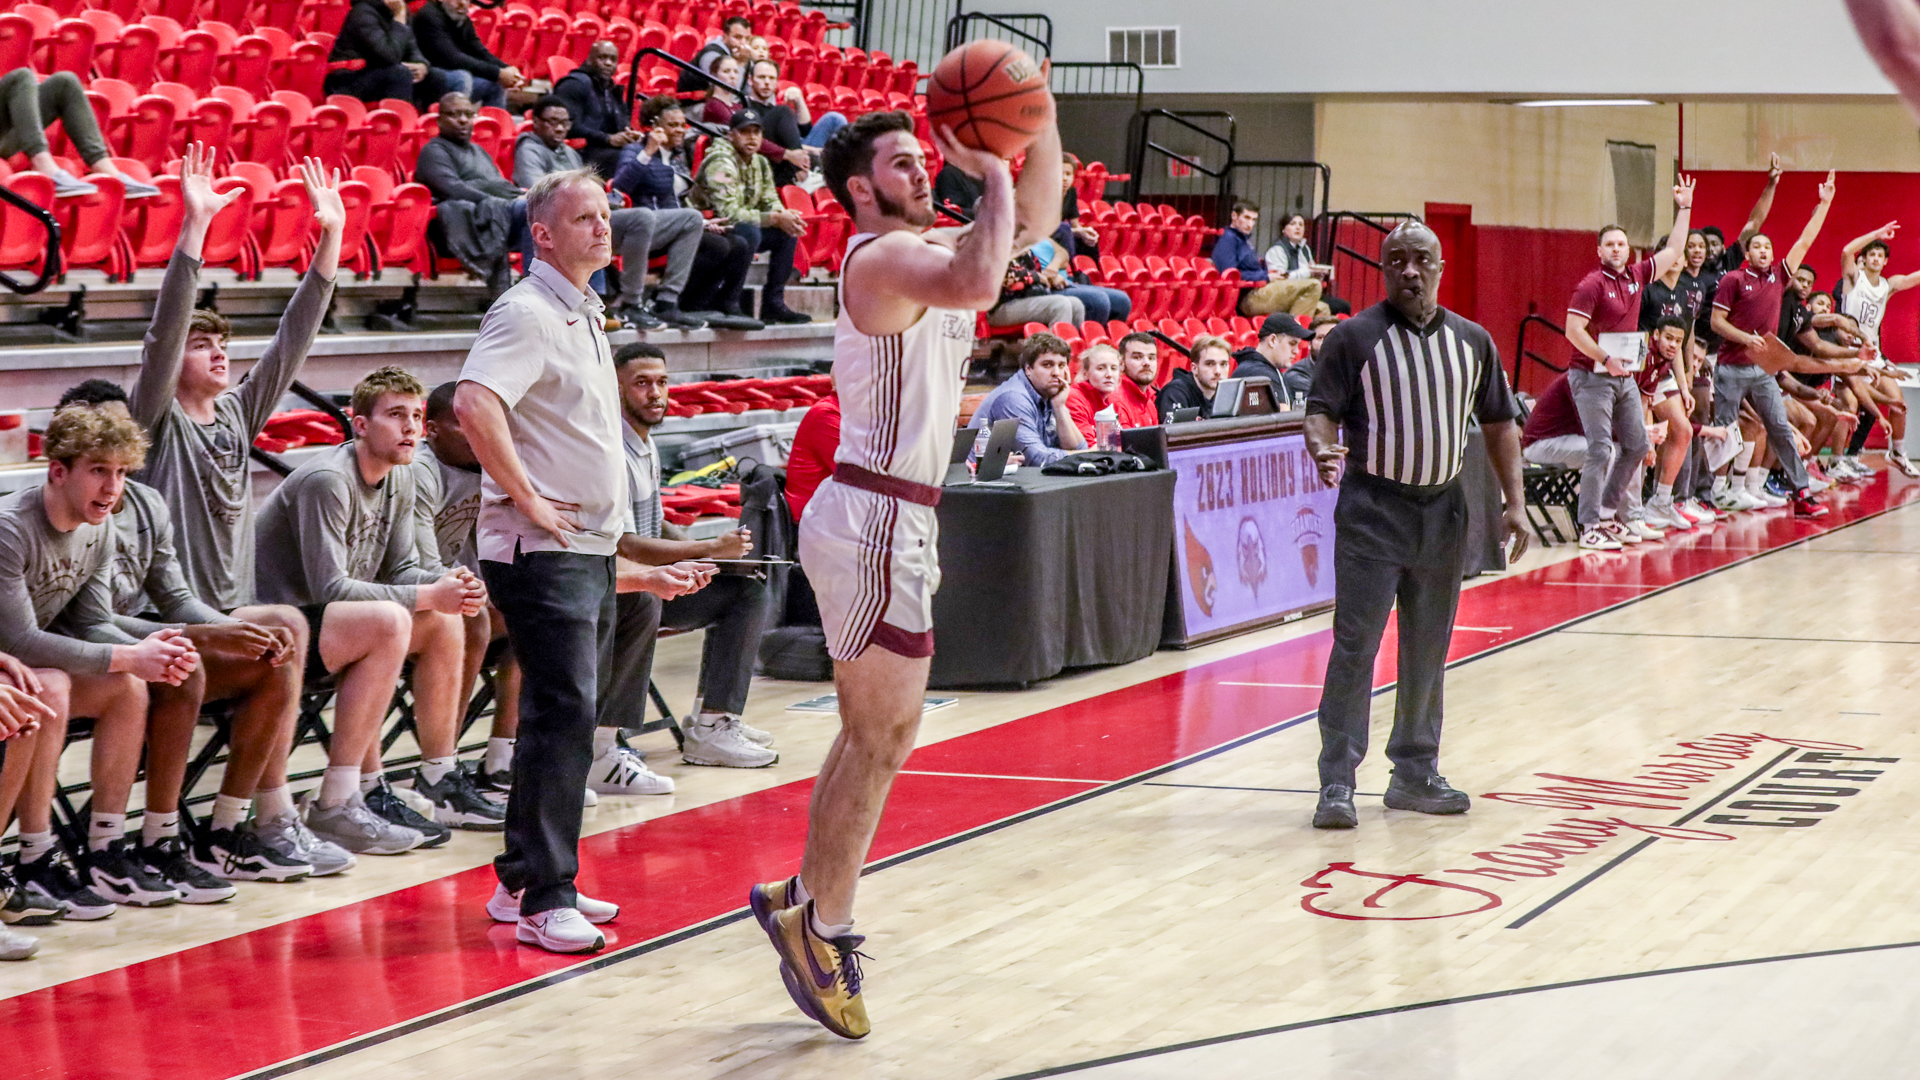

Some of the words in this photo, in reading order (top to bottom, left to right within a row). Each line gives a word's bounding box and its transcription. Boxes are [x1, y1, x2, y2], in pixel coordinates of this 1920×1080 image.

[1859, 300, 1879, 328] 12
[1196, 459, 1234, 513] 2023
[1240, 450, 1296, 505] HOLIDAY
[1480, 732, 1864, 811] Murray
[1703, 752, 1901, 828] COURT
[1300, 816, 1737, 921] Franny
